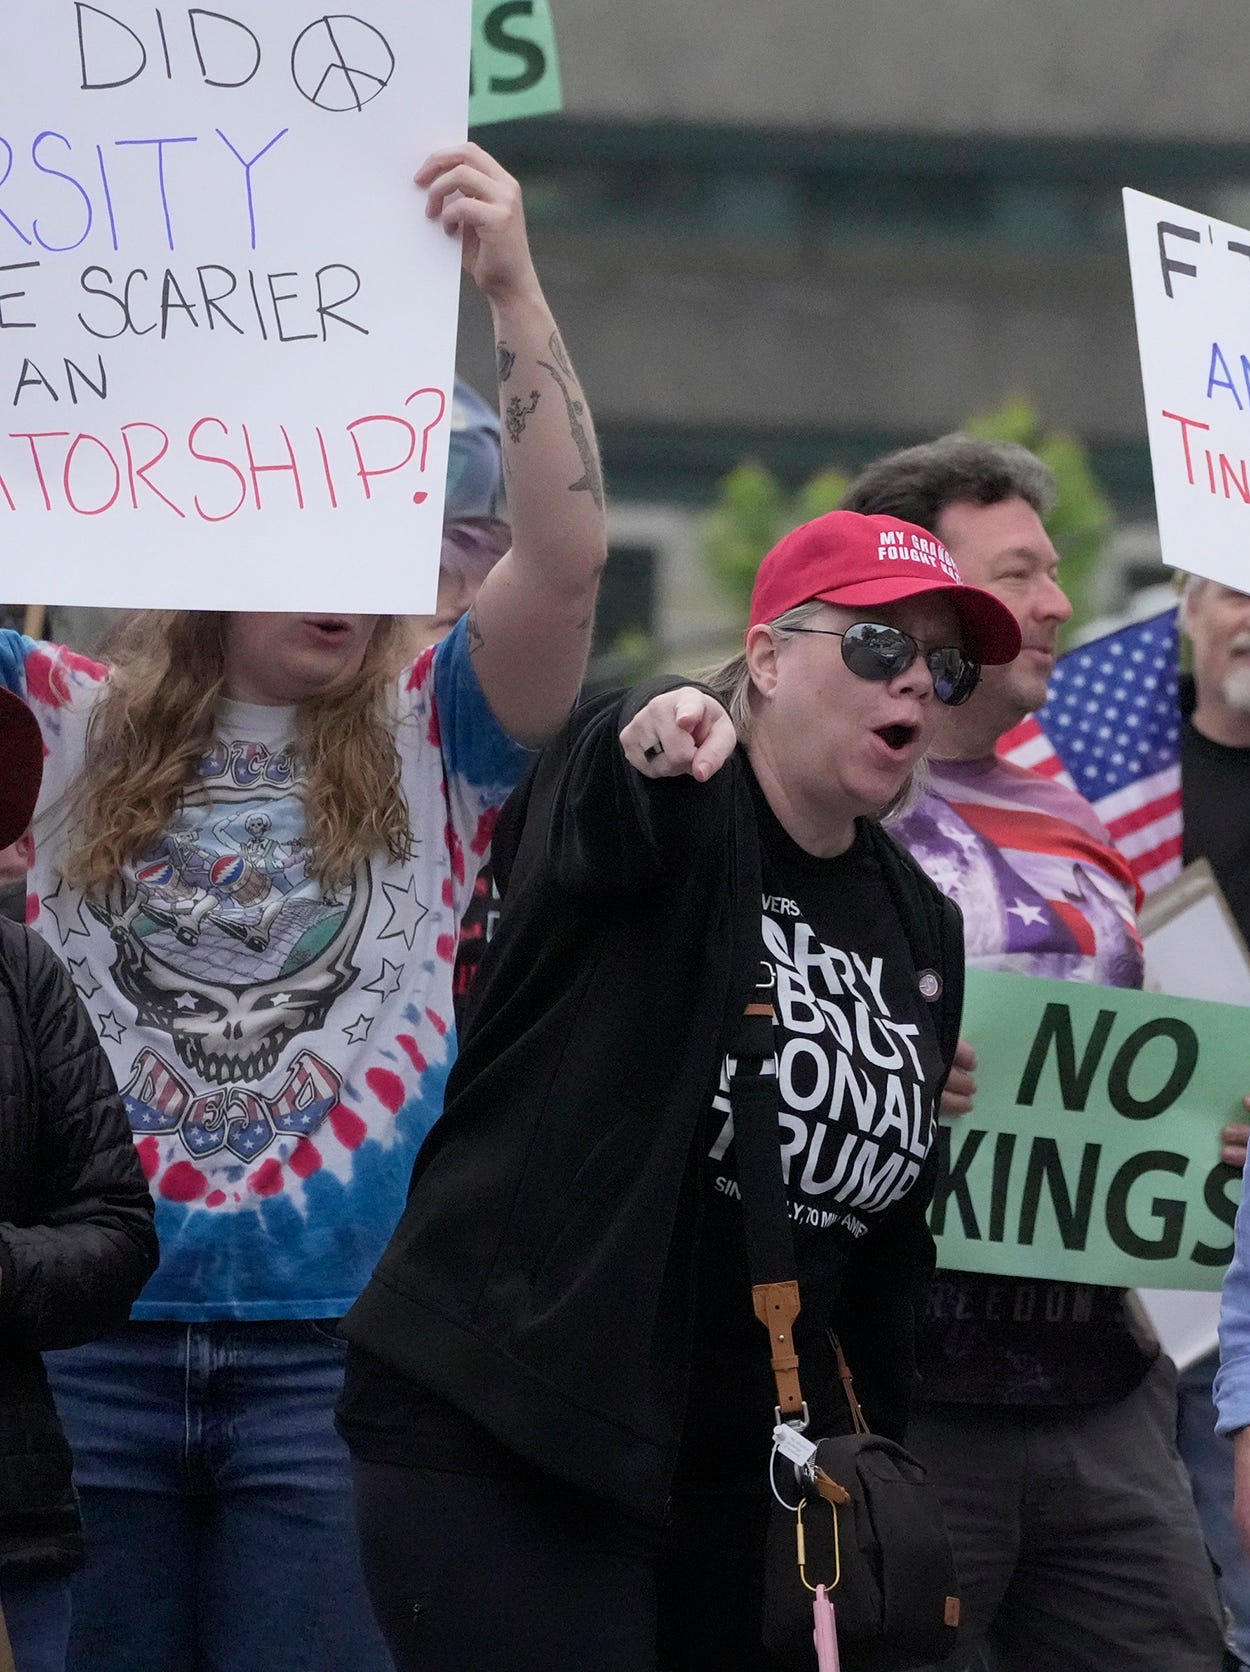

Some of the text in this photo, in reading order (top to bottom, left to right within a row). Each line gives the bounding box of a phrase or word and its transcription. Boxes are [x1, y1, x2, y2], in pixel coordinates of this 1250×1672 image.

[74, 2, 261, 89] DID
[470, 0, 547, 96] S
[78, 263, 369, 342] SCARIER
[14, 353, 107, 406] AN
[0, 387, 445, 522] TORSHIP?
[877, 546, 938, 568] FOUGHT
[879, 531, 904, 546] MY
[772, 963, 925, 1082] BOUT
[1015, 1002, 1200, 1121] NO
[719, 1037, 939, 1161] ONAL
[930, 1125, 1245, 1268] KINGS
